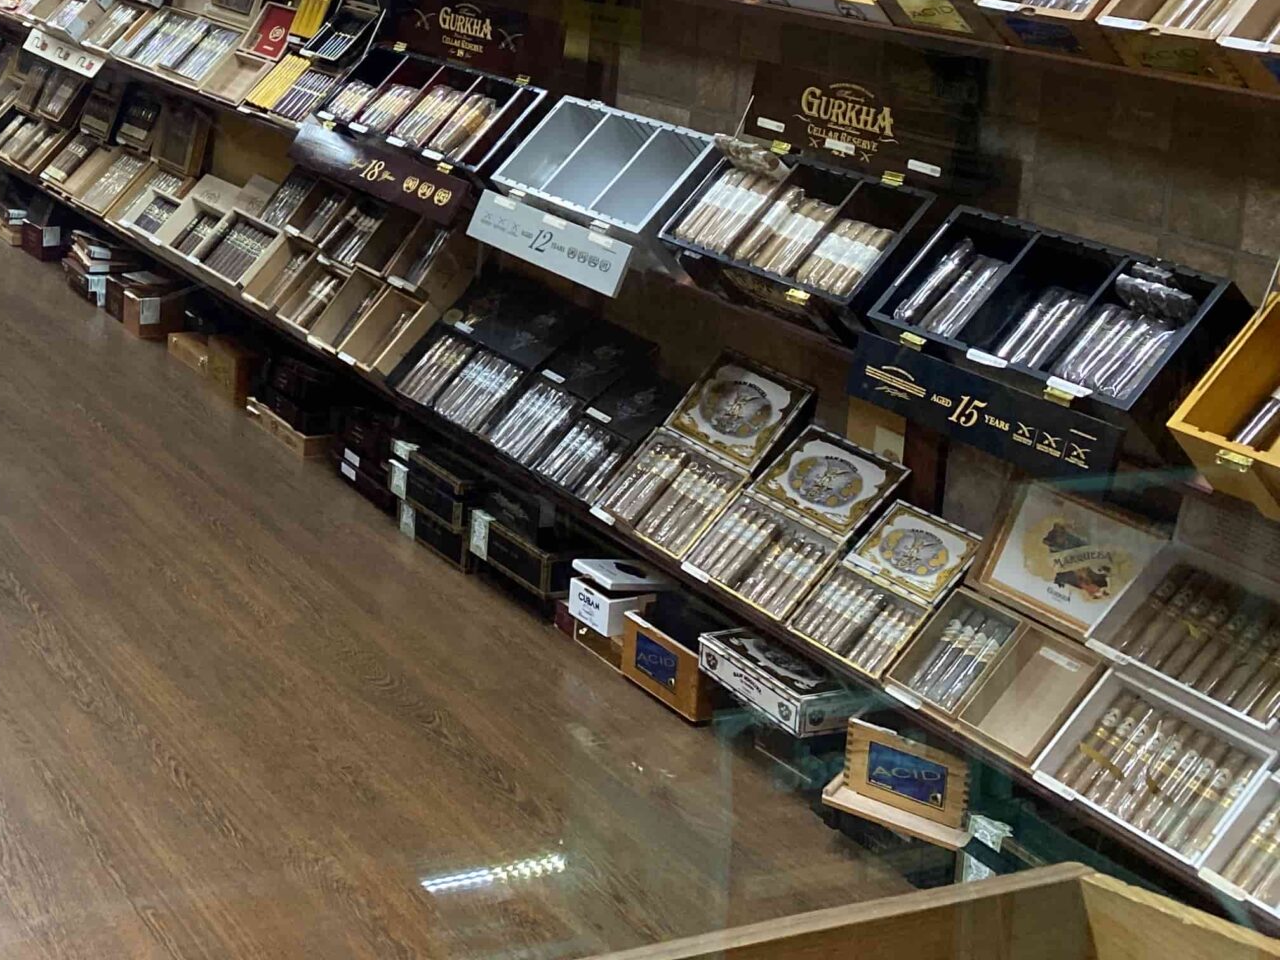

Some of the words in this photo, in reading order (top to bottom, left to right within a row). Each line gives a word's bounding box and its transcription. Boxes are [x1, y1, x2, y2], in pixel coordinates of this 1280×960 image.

[910, 4, 955, 18] ACID
[439, 6, 492, 40] GURKHA
[801, 86, 894, 137] GURKHA
[808, 124, 839, 140] CELLAR
[840, 133, 878, 152] RESERVE
[359, 159, 385, 181] 18
[528, 229, 553, 253] 12
[930, 393, 952, 408] AGED
[948, 395, 988, 428] 15
[984, 414, 1011, 432] YEARS
[578, 591, 600, 610] CUBAN
[637, 652, 675, 667] ACID
[872, 766, 941, 781] ACID
